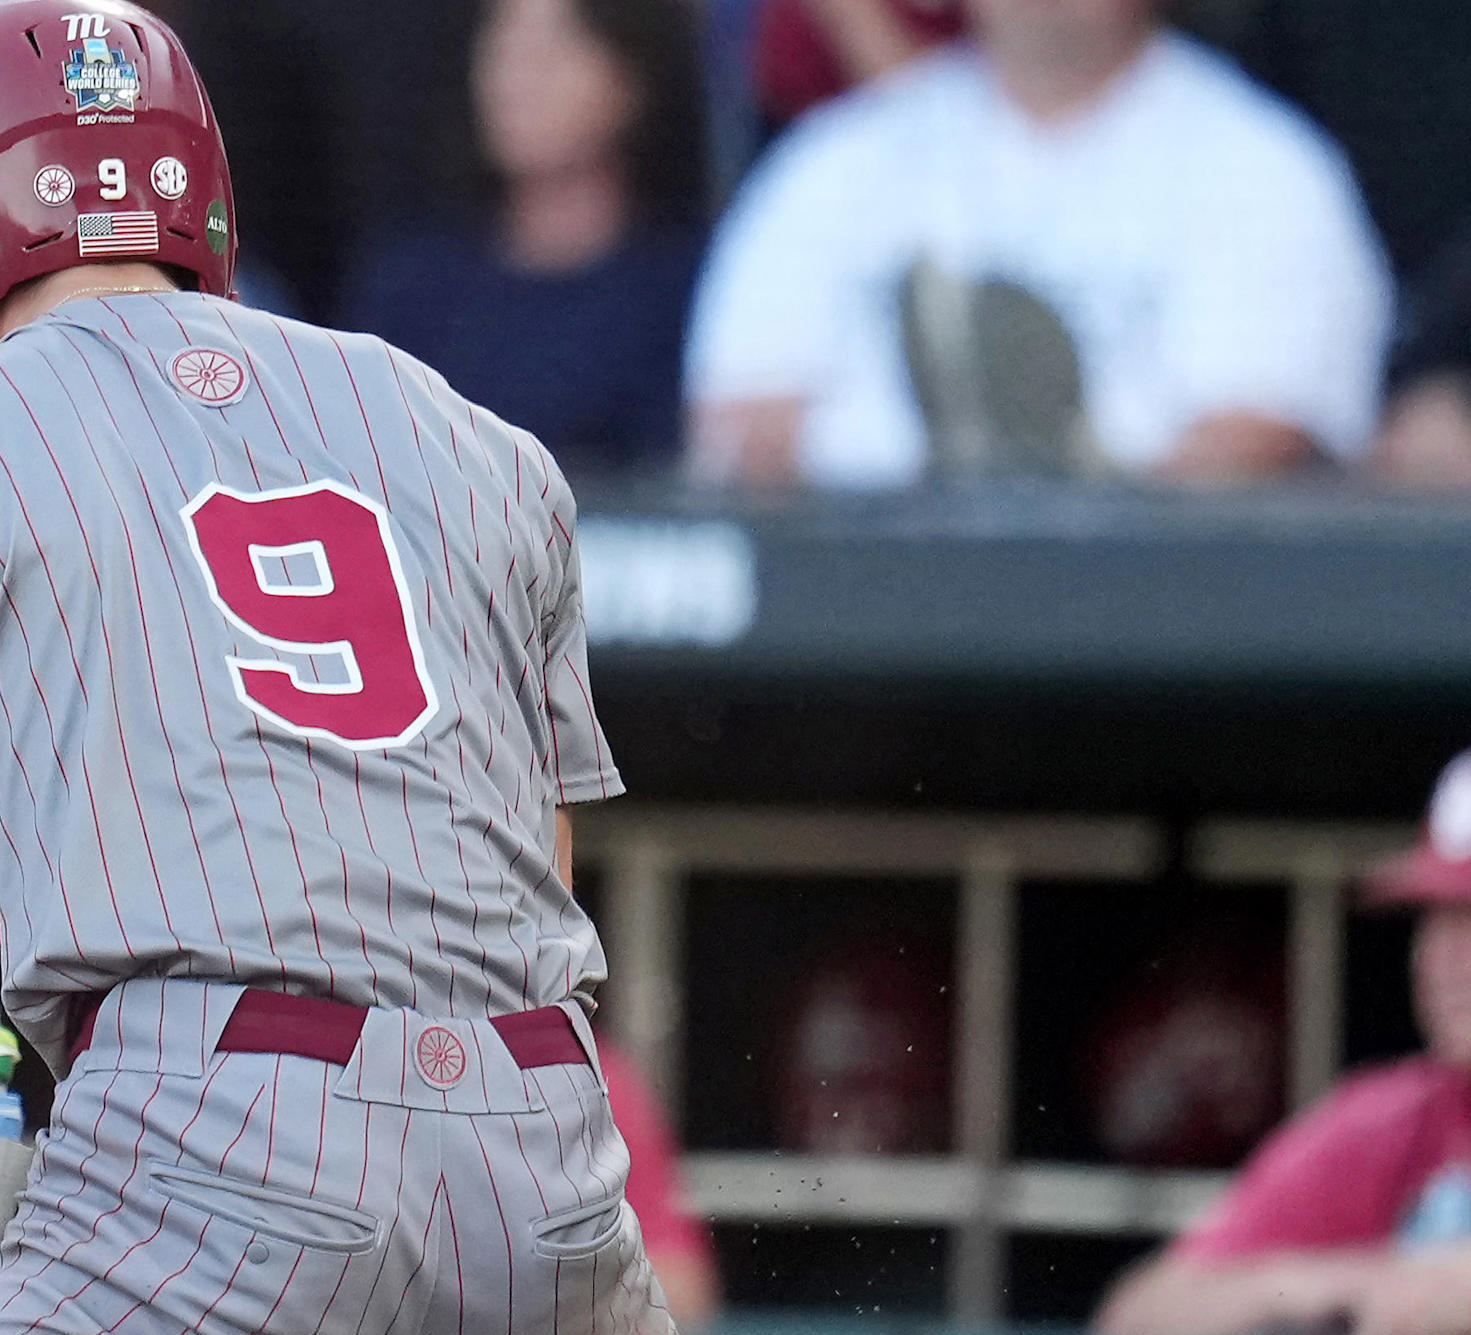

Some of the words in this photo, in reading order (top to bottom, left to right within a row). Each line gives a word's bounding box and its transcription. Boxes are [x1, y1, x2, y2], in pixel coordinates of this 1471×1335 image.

[81, 67, 121, 79] COLLEGE
[68, 77, 103, 90] WORLD
[104, 77, 136, 89] SERIES
[97, 158, 128, 201] 9
[208, 216, 228, 234] ALTO
[178, 477, 440, 751] 9
